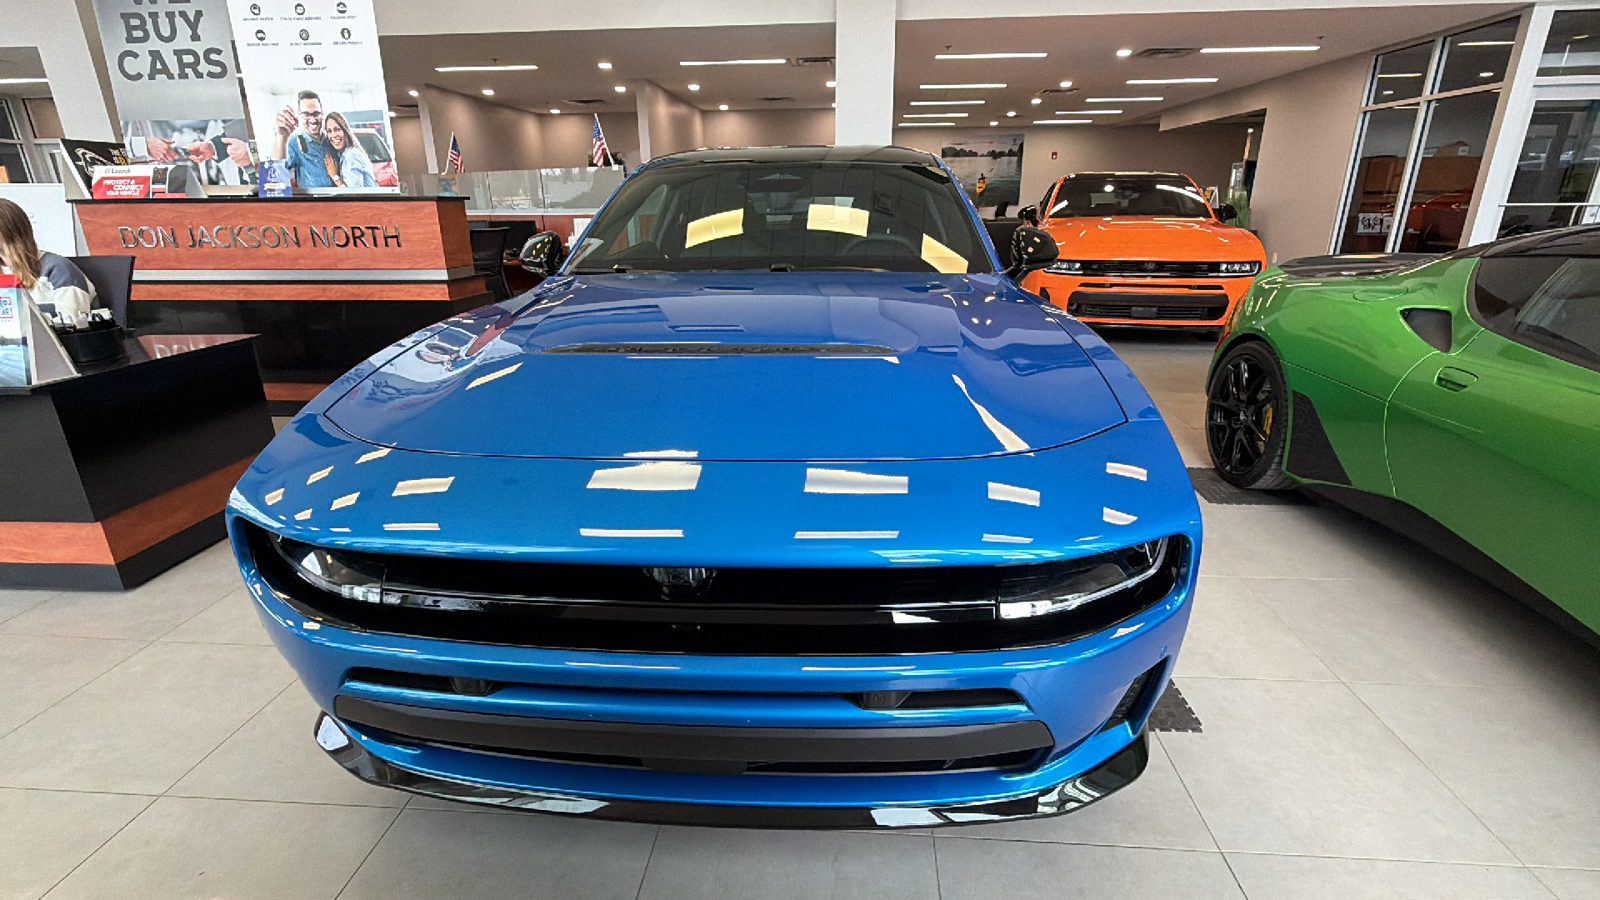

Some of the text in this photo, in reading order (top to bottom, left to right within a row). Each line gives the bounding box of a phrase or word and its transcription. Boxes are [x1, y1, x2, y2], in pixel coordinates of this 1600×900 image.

[120, 10, 204, 43] BUY
[117, 47, 228, 81] CARS
[118, 225, 402, 248] DON JACKSON NORTH
